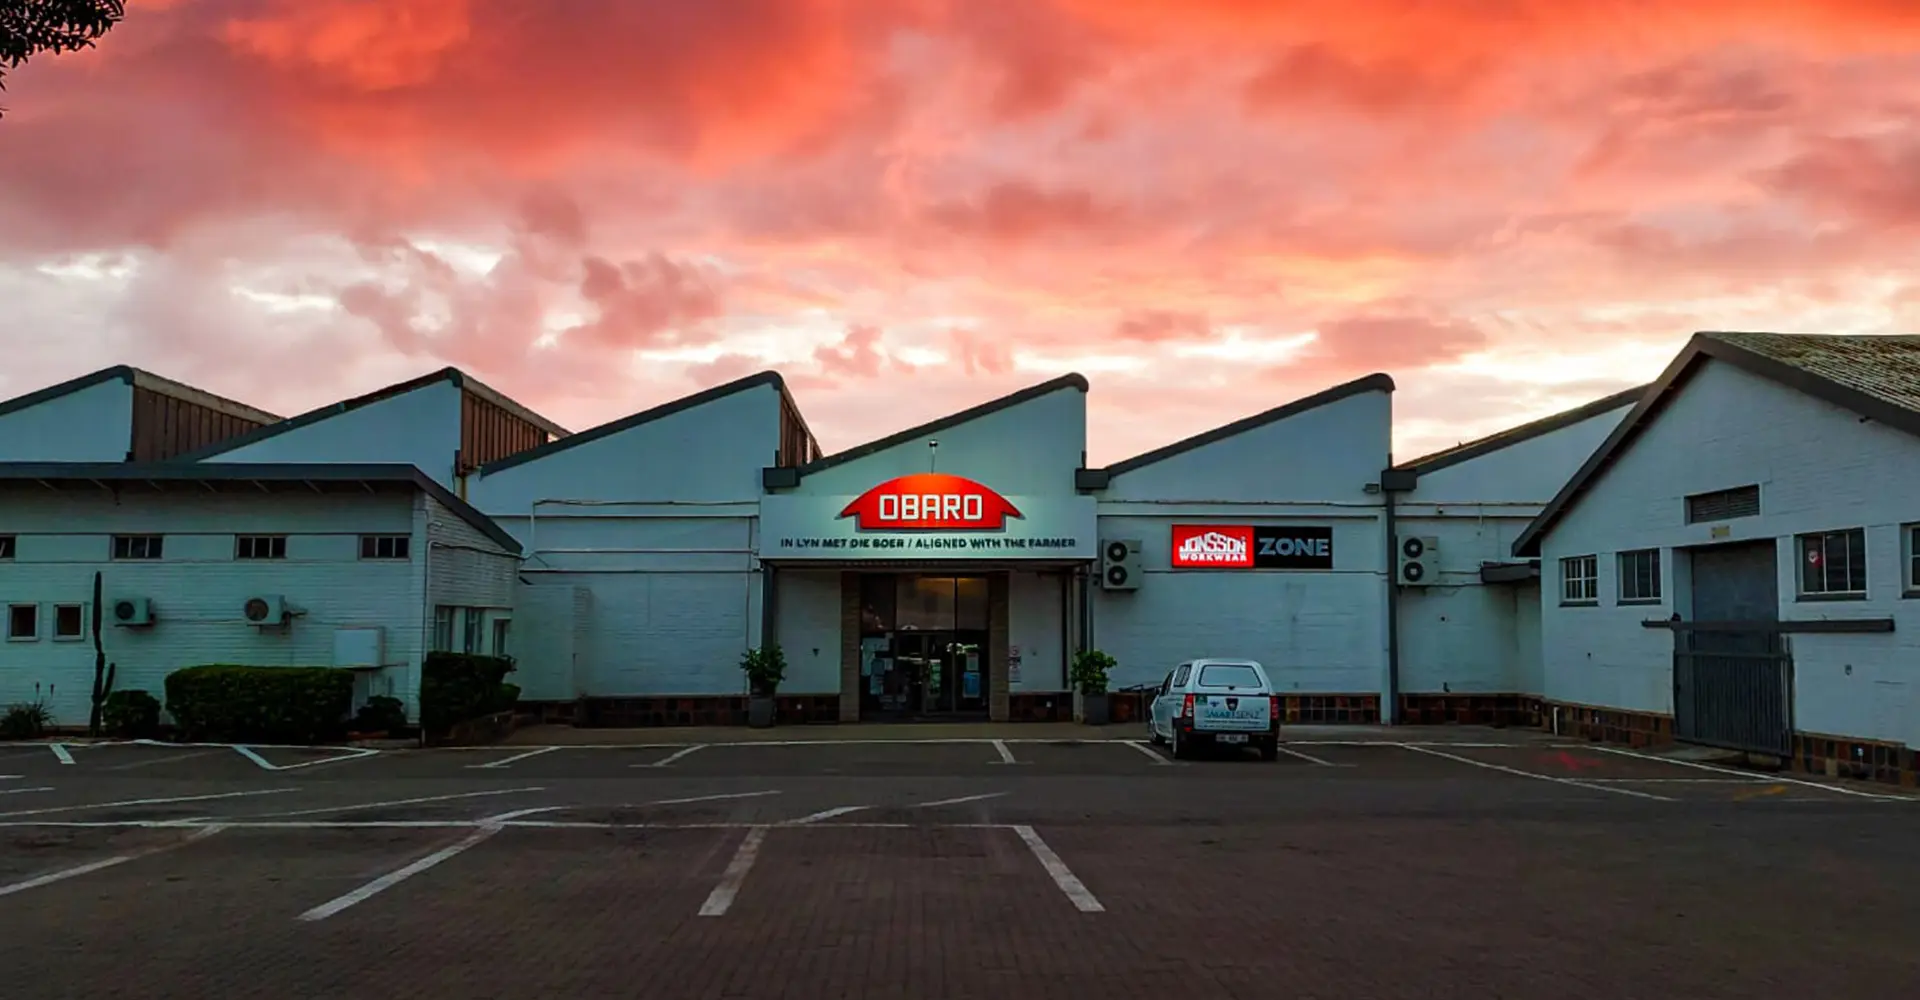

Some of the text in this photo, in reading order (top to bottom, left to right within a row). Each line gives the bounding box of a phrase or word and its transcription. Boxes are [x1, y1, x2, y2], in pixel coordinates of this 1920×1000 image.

[879, 494, 983, 521] OBARO
[780, 538, 793, 548] IN
[796, 538, 819, 548] LYN
[822, 538, 848, 548] MET
[850, 538, 870, 548] DIE
[872, 538, 904, 548] BOER
[915, 538, 967, 548] ALIGNED
[969, 538, 1000, 548] WITH
[1003, 538, 1026, 548] THE
[1028, 538, 1076, 548] FARMER
[1178, 531, 1246, 554] JONSSON
[1258, 537, 1330, 556] ZONE
[1179, 553, 1247, 562] WORKWEAR
